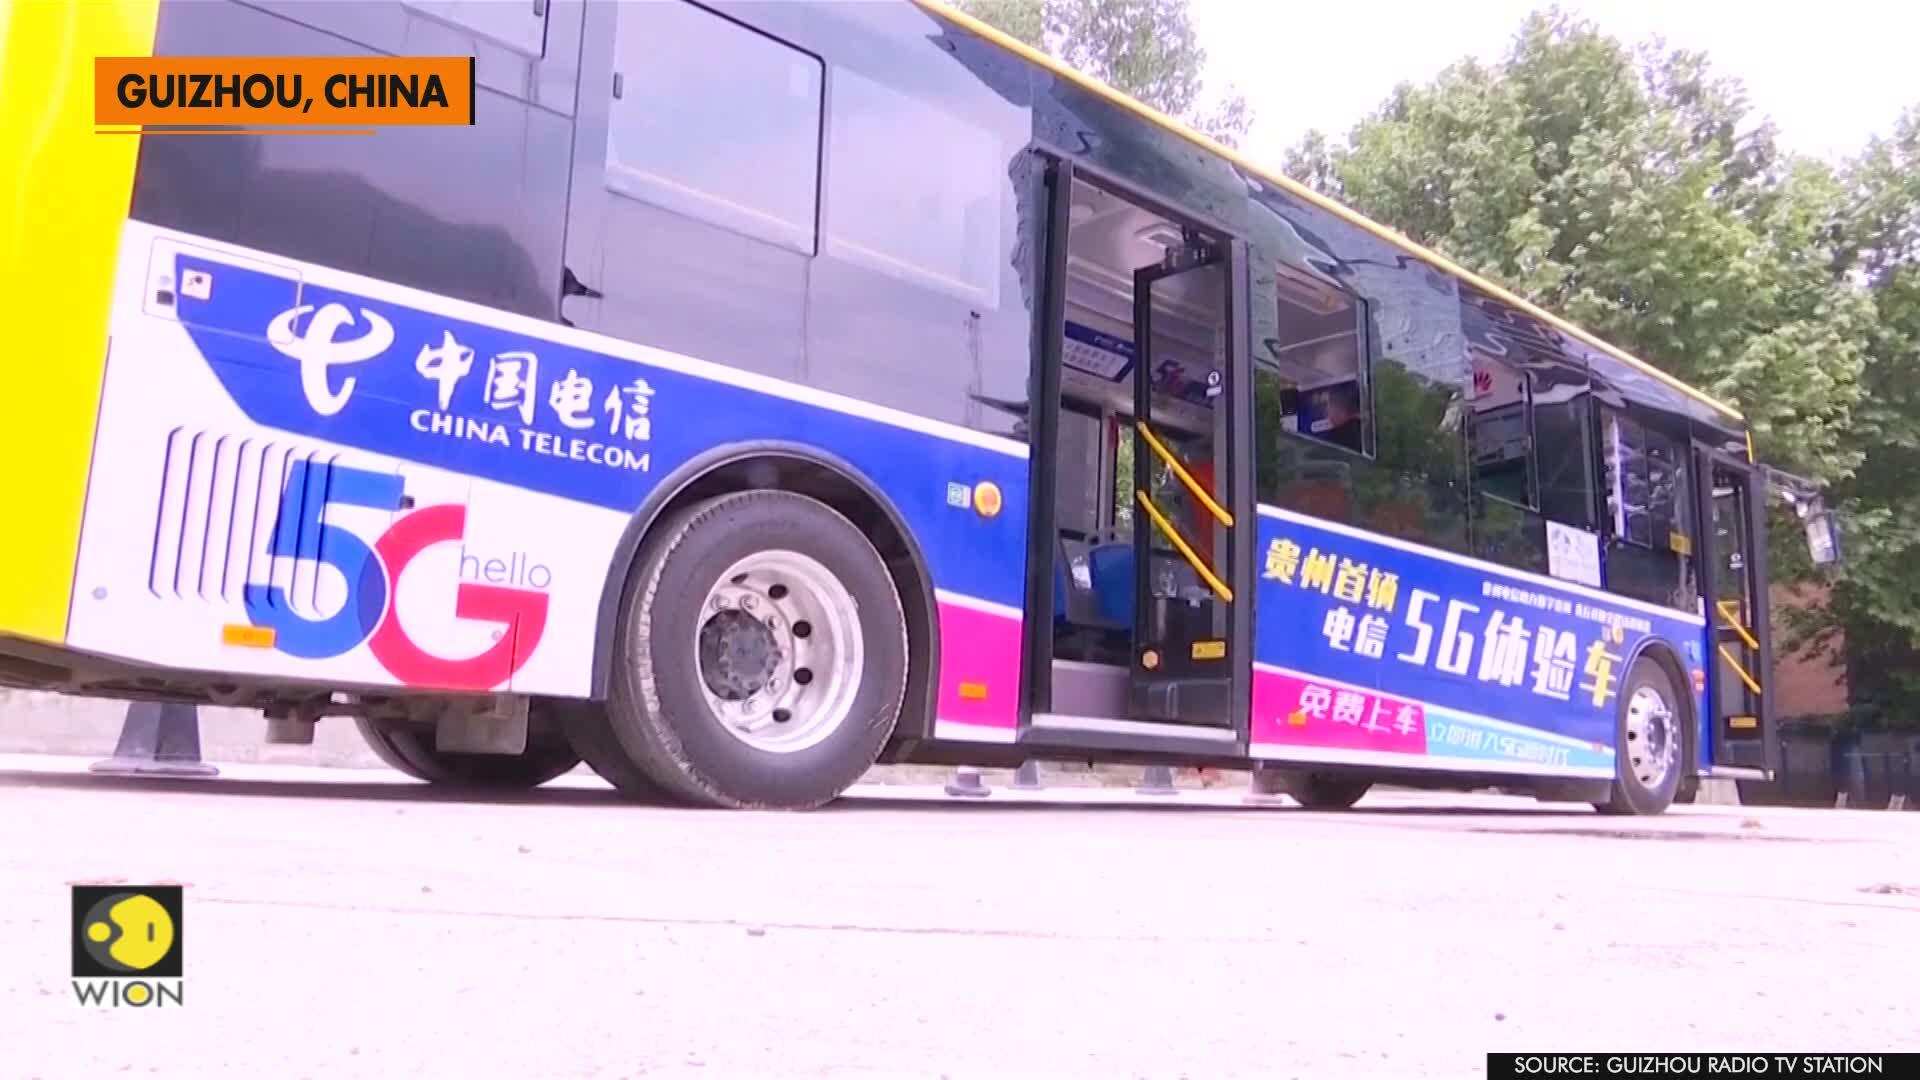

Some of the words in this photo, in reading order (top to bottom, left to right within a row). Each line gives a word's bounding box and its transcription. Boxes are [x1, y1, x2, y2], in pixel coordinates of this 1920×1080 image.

[415, 329, 656, 441] 中国电信
[410, 409, 511, 447] CHINA
[519, 428, 650, 472] TELECOM
[242, 459, 549, 692] 5G
[459, 543, 551, 588] hello
[1261, 537, 1400, 613] 贵州首辆
[1322, 605, 1390, 660] 电信
[1397, 587, 1623, 708] 5G体验车
[1299, 684, 1419, 736] 免费上车
